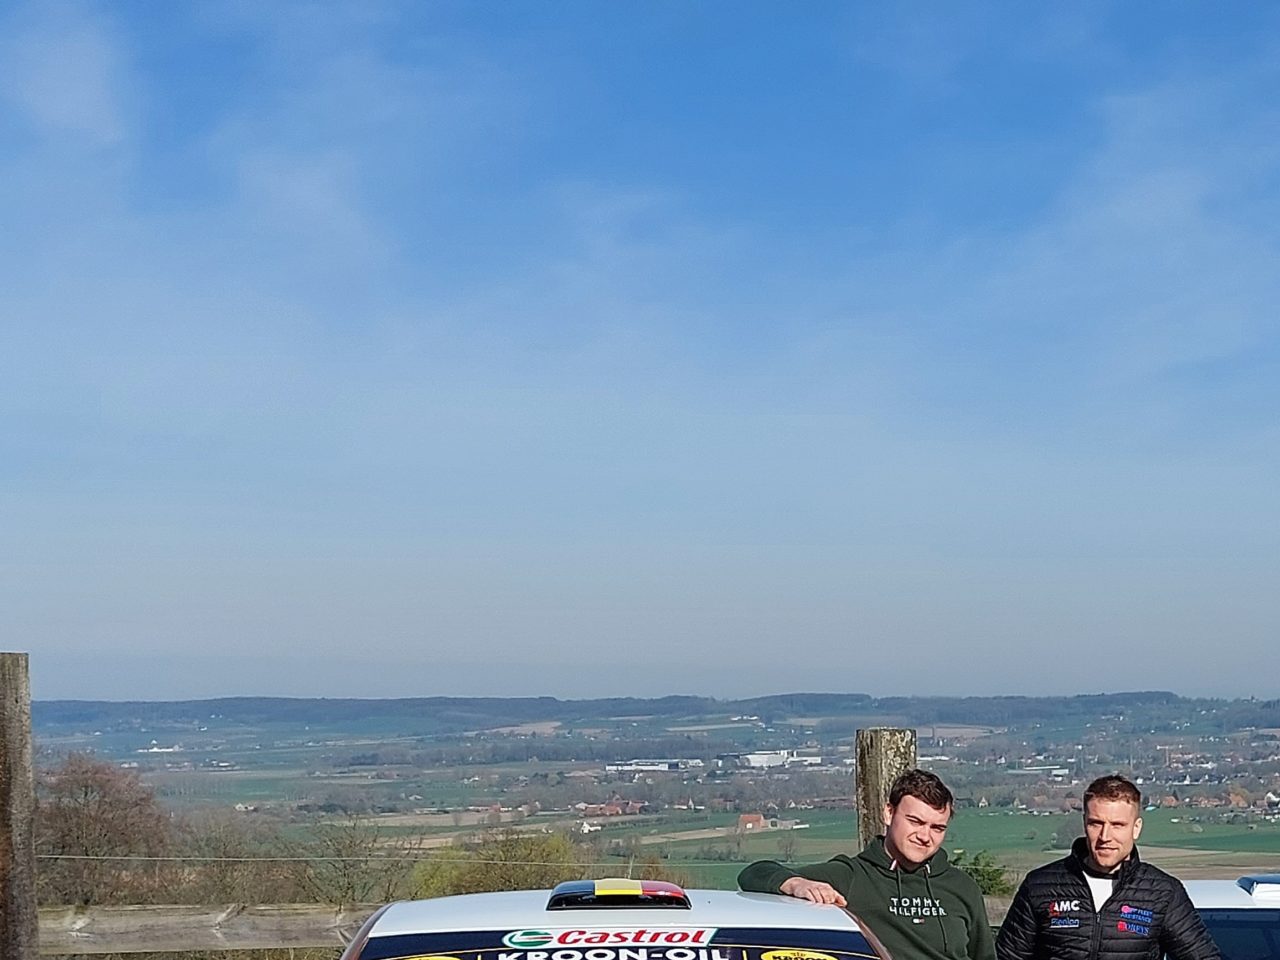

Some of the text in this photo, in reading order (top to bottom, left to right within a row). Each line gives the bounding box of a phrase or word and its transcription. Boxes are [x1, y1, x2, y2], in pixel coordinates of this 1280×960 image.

[890, 896, 940, 907] TOMMY
[889, 906, 948, 917] HILFIGER
[557, 928, 706, 946] Castrol
